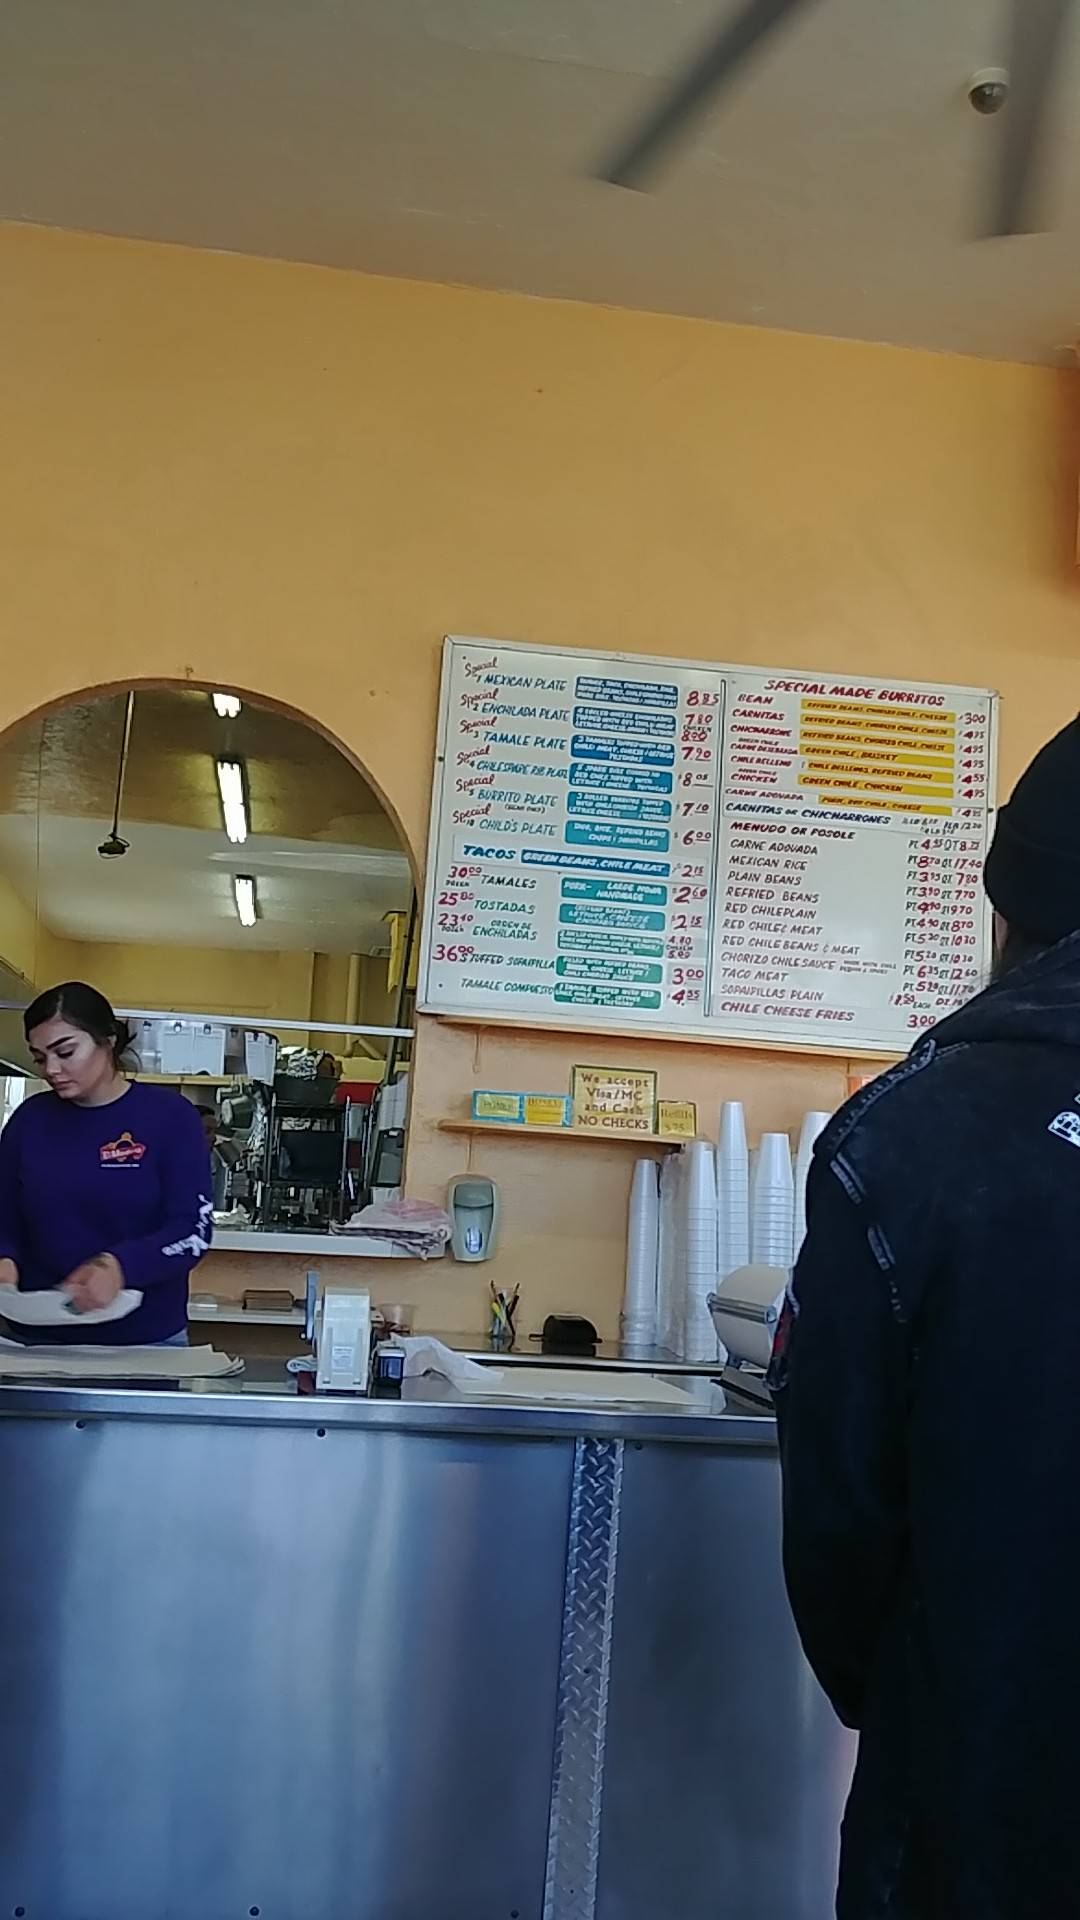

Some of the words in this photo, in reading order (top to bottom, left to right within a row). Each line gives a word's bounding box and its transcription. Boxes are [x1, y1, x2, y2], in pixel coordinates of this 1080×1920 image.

[484, 674, 532, 689] MEXICAN
[534, 678, 568, 691] PLATE
[738, 693, 774, 705] BEAN
[764, 679, 828, 695] SPECIAL
[829, 686, 875, 700] MADE
[877, 690, 946, 706] BURRITOS
[482, 702, 537, 717] ENCHILADA
[539, 708, 570, 721] PLATE
[732, 708, 785, 721] CARNITAS
[484, 731, 530, 747] TAMALE
[533, 736, 568, 750] PLATE
[730, 743, 756, 752] CARNE
[546, 767, 569, 779] PLATE
[730, 773, 778, 784] CHICKEN
[478, 789, 520, 804] BURRITO
[523, 793, 559, 808] PLATE
[725, 788, 758, 797] CARNE
[725, 802, 784, 815] CARNITAS
[801, 808, 892, 825] CHICHARRONES
[480, 818, 518, 833] CHILD'S
[520, 822, 558, 837] PLATE
[730, 821, 787, 834] MENUDO
[790, 826, 808, 836] OR
[730, 838, 766, 851] CARNE
[768, 842, 818, 855] ADOVADA
[464, 844, 516, 860] TACOS
[600, 859, 632, 870] CHILE
[632, 862, 665, 873] MEAT
[728, 855, 780, 868] MEXICAN
[783, 859, 808, 871] RICE
[480, 874, 537, 889] TAMALES
[727, 870, 761, 883] PLAIN
[764, 873, 802, 886] BEANS
[725, 886, 775, 900] REFRIED
[782, 891, 820, 904] BEANS
[474, 899, 536, 915] TOSTADAS
[724, 902, 748, 914] RED
[473, 925, 539, 942] ENCHILADAS
[721, 918, 745, 930] RED
[789, 925, 824, 937] MEAT
[721, 935, 745, 946] RED
[748, 937, 781, 949] CHILE
[782, 941, 819, 953] BEANS
[831, 945, 861, 956] MEAT
[720, 951, 768, 965] CHORIZO
[770, 956, 800, 968] CHILE
[801, 959, 837, 971] SAUCE
[720, 967, 752, 980] TACO
[753, 970, 790, 982] MEAT
[461, 977, 503, 992] TAMALE
[720, 983, 786, 999] SOPAIPILLAS
[790, 990, 825, 1003] PLAIN
[720, 1001, 761, 1014] CHILE
[763, 1004, 813, 1019] CHEESE
[815, 1009, 856, 1022] FRIES
[580, 1072, 600, 1084] We
[607, 1077, 649, 1089] accept
[584, 1102, 607, 1113] and
[612, 1103, 644, 1115] Cash
[577, 1115, 599, 1127] NO
[602, 1117, 650, 1130] CHECKS
